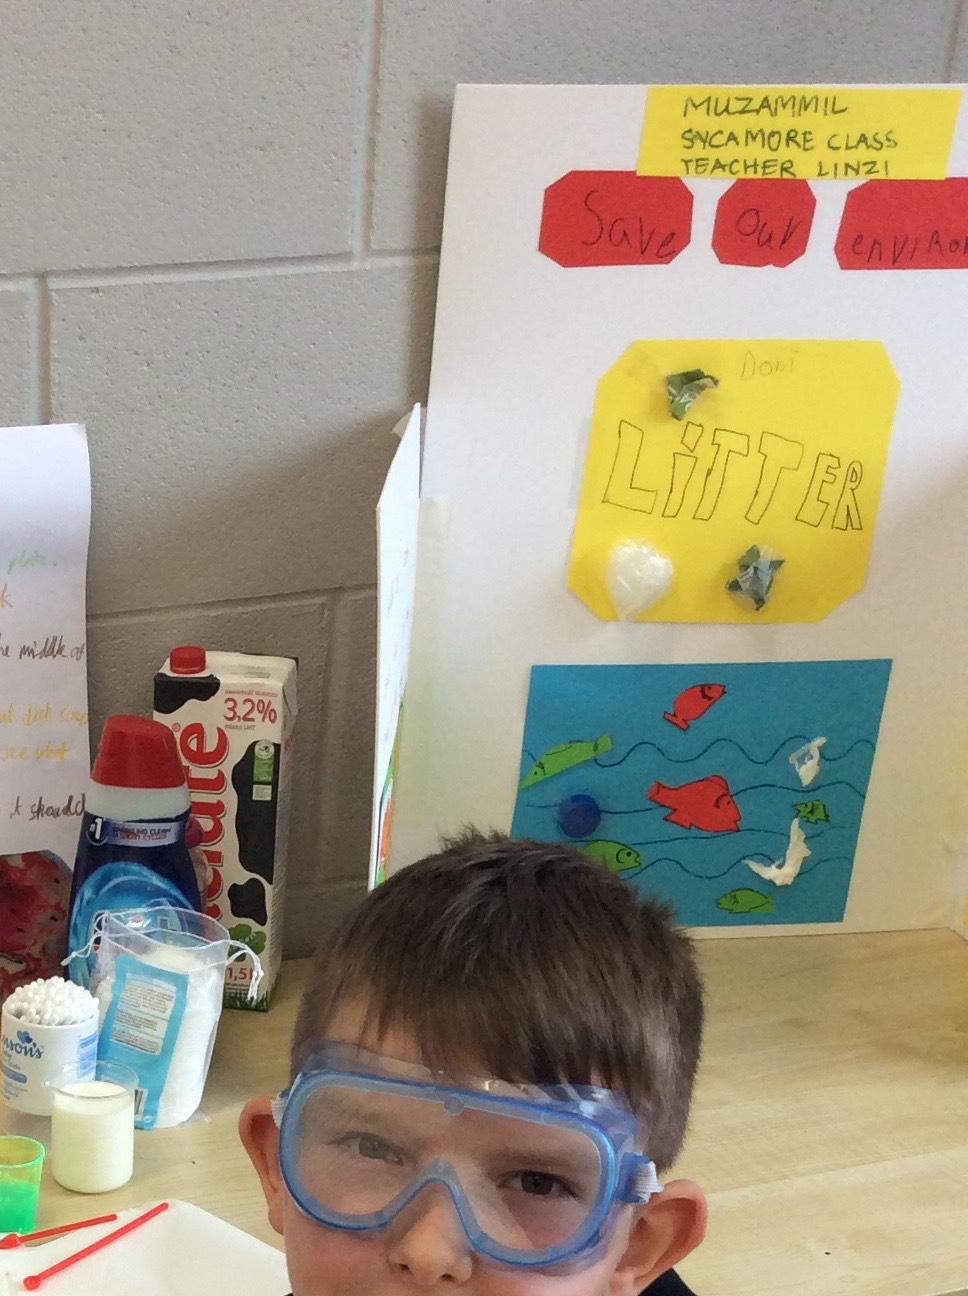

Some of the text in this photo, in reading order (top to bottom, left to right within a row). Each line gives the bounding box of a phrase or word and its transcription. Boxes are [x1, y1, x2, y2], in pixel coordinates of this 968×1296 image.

[683, 95, 848, 118] MUZAMMIL
[680, 127, 899, 152] SYCAMORE CLASS
[680, 157, 889, 178] TEACHER LINZI
[582, 189, 678, 258] Save
[224, 697, 277, 724] 3,2%
